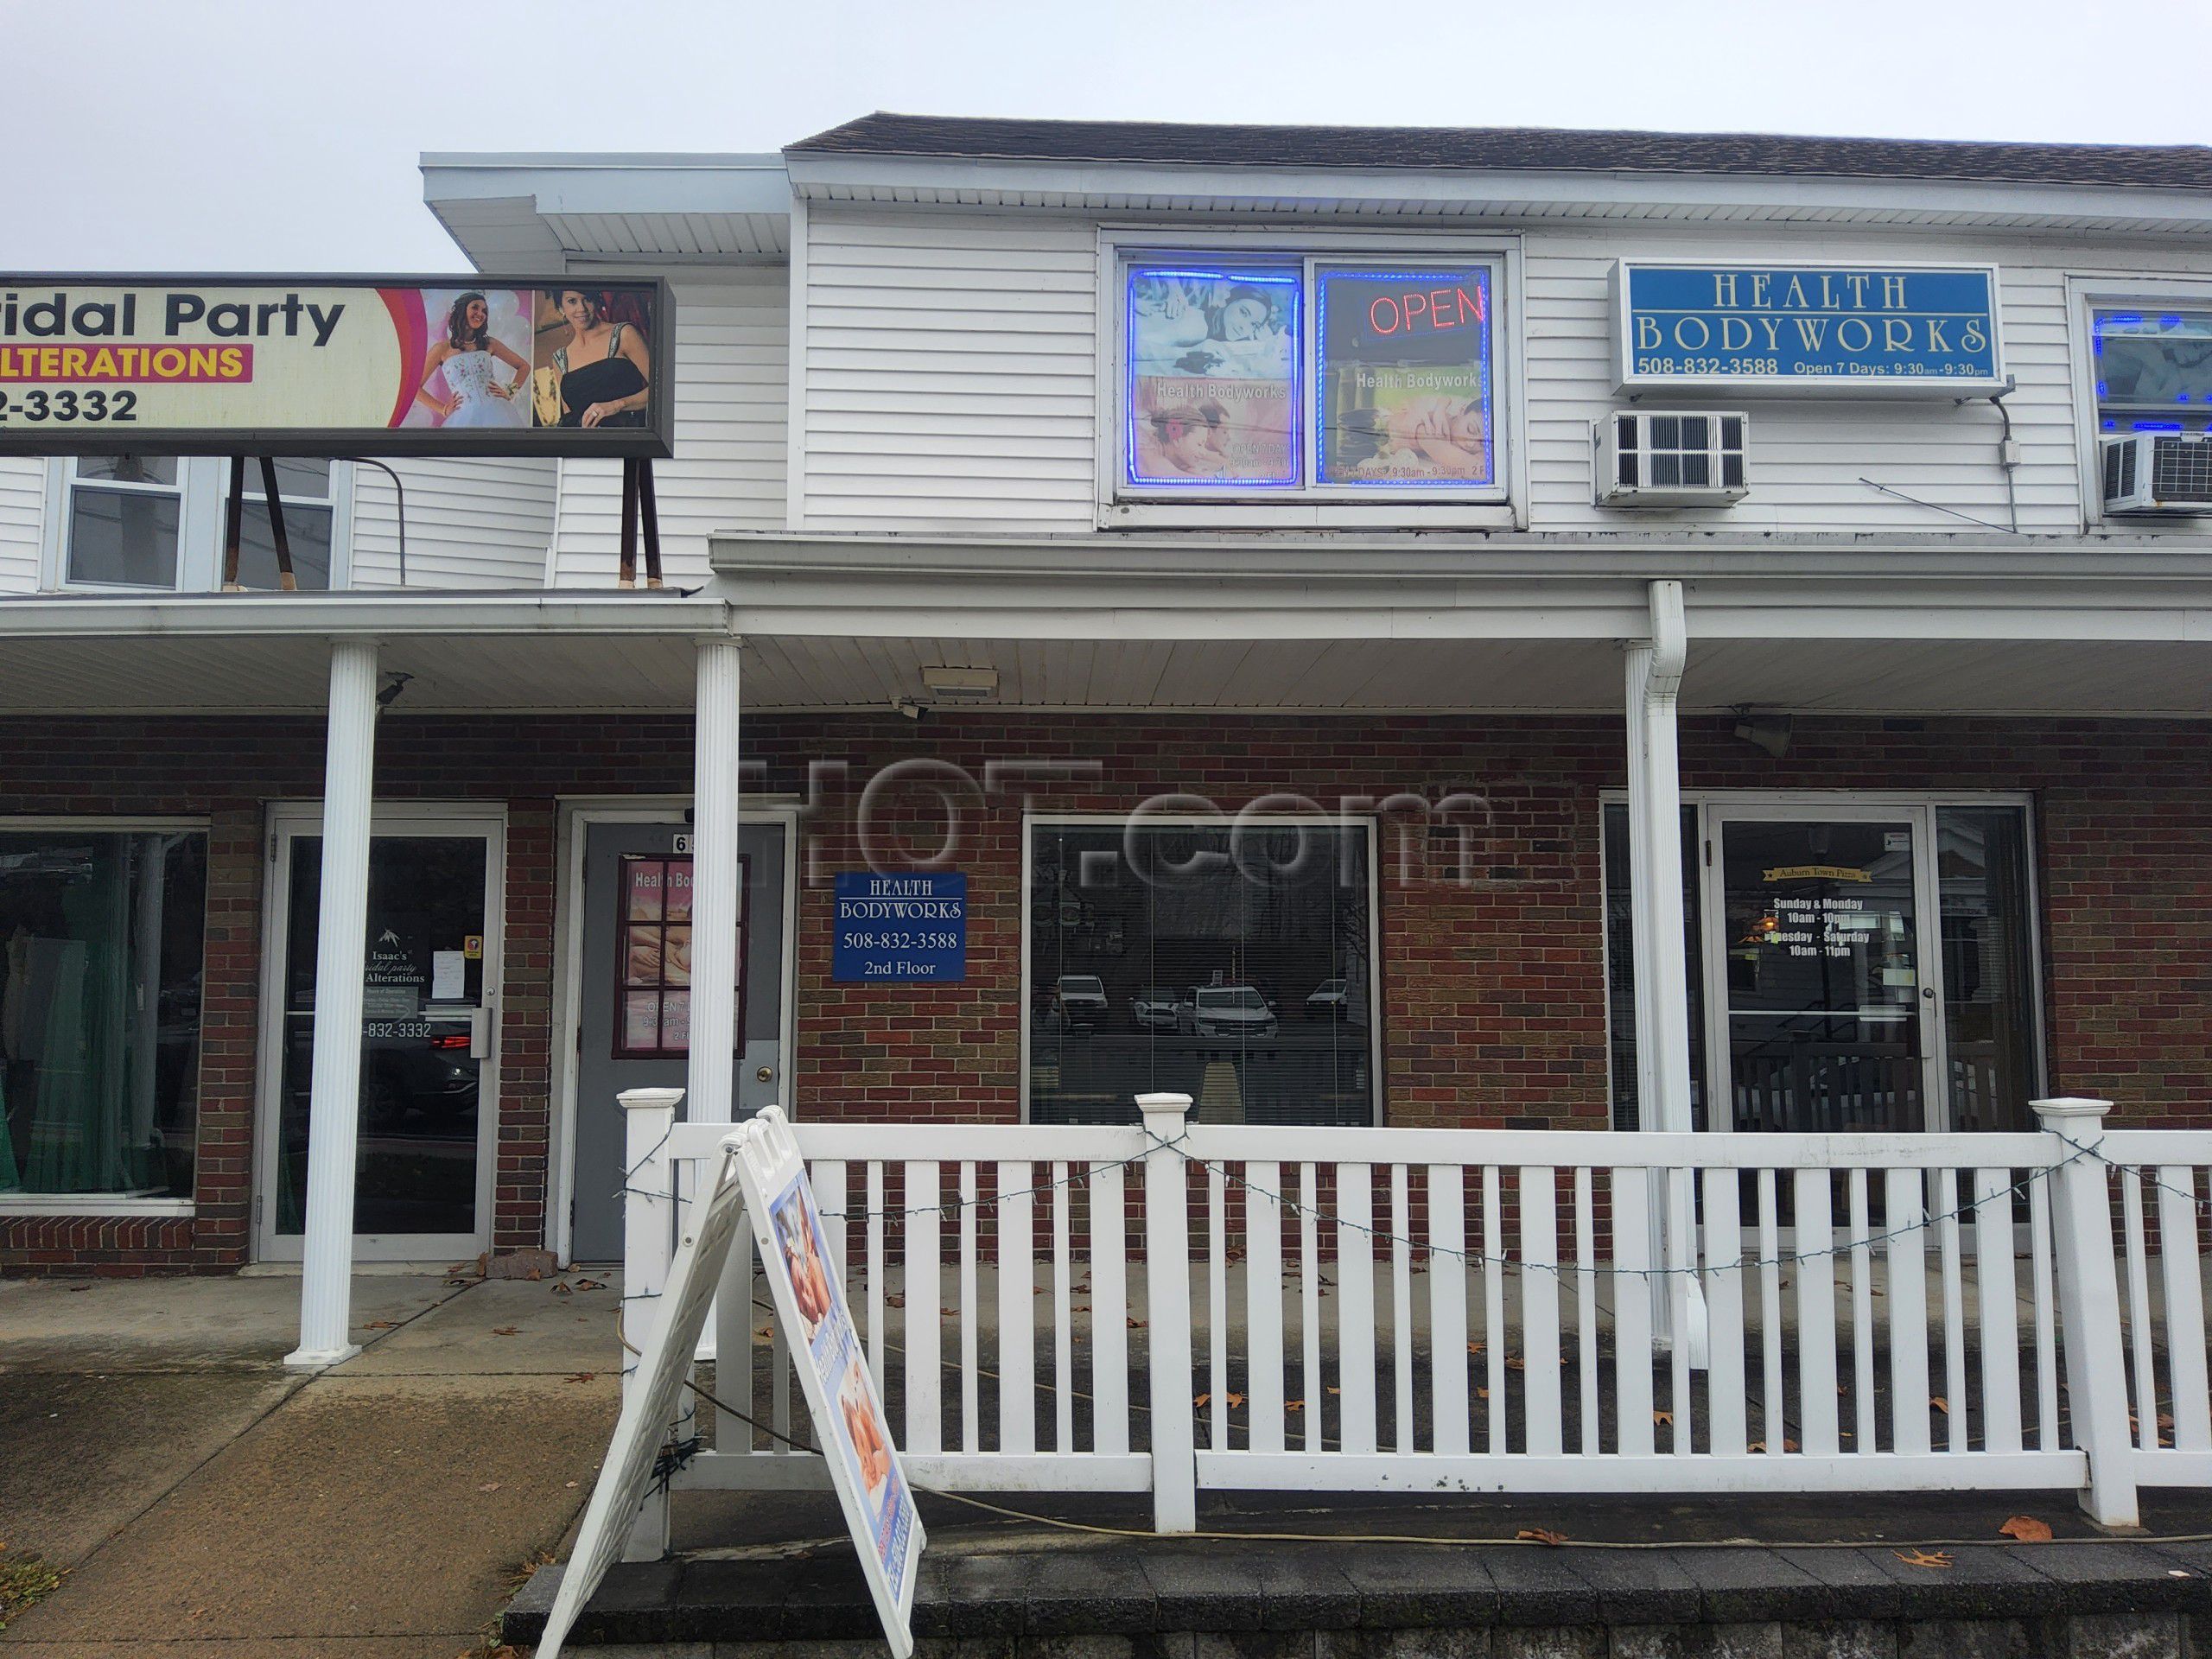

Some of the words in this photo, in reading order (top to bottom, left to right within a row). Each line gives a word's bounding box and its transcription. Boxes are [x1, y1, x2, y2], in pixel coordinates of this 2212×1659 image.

[1712, 273, 1908, 310] HEALTH
[1370, 286, 1484, 334] OPEN
[0, 293, 137, 337] idal
[164, 293, 345, 346] Party
[1637, 315, 1986, 353] BODYWORKS
[1638, 358, 1778, 375] 508-832-3588
[1794, 361, 1832, 376] Open
[1836, 362, 1845, 374] 7
[1849, 361, 1890, 377] Days:
[1357, 373, 1402, 389] Health
[1158, 382, 1204, 398] Health
[1209, 385, 1287, 403] Bodyworks
[1358, 467, 1382, 478] DAYS
[1392, 467, 1425, 478] 9:30am
[677, 836, 694, 852] 6
[635, 872, 673, 887] Healh
[1780, 868, 1811, 878] Auburn
[1813, 868, 1835, 878] Town
[869, 880, 933, 896] HEALTH
[840, 902, 962, 918] BODYWORKS
[1773, 898, 1812, 910] Sunday
[1814, 899, 1821, 909] &
[1822, 899, 1863, 910] Monday
[1787, 912, 1815, 923] 10am
[1822, 912, 1851, 925] 10pm
[842, 932, 957, 949] 508-832-3588
[1770, 931, 1813, 944] Tuesday
[1823, 931, 1870, 944] Saturday
[372, 950, 408, 960] Isaac's
[1789, 945, 1817, 957] 10am
[1824, 945, 1851, 957] 11pm
[864, 961, 892, 975] 2nd
[896, 961, 936, 975] Floor
[365, 973, 425, 982] Alterations
[647, 1001, 677, 1012] OEN
[643, 1016, 679, 1027] 9:3am
